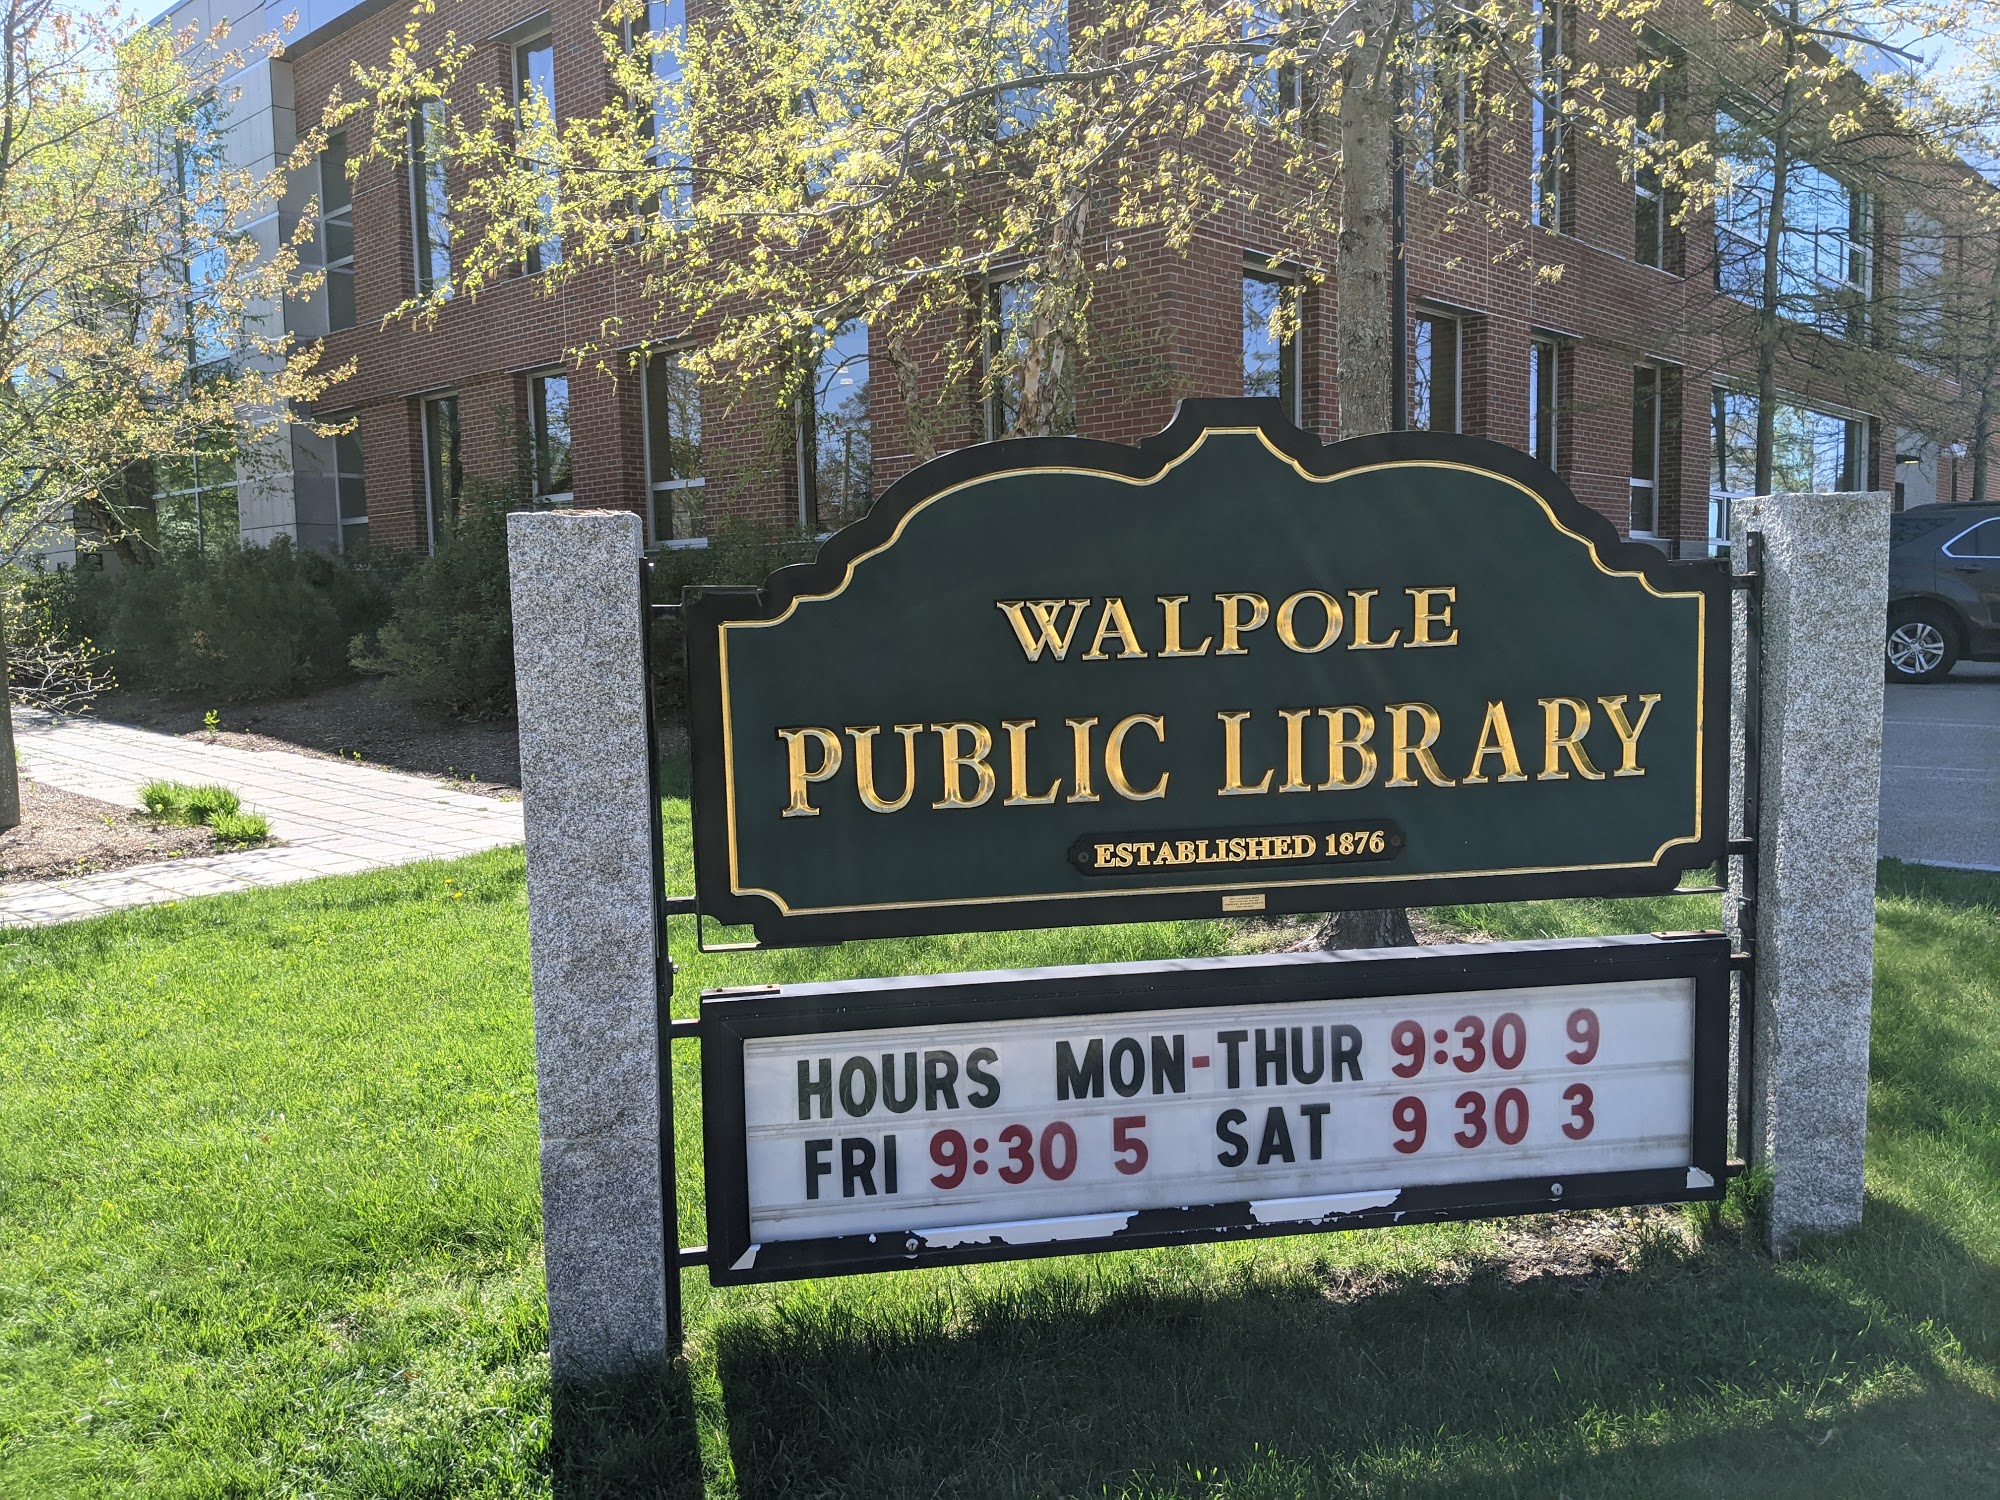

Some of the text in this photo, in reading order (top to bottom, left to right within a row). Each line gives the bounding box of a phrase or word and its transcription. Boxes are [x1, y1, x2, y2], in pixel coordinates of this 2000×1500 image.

[996, 586, 1459, 662] WALPOLE
[777, 693, 1662, 818] PUBLIC LIBRARY
[1093, 831, 1385, 869] ESTABLISHED 1876
[797, 1008, 1600, 1121] HOURS MON-THUR 9:30 9
[804, 1083, 1595, 1200] FRI 9:30 5 SAT 9 30 3
